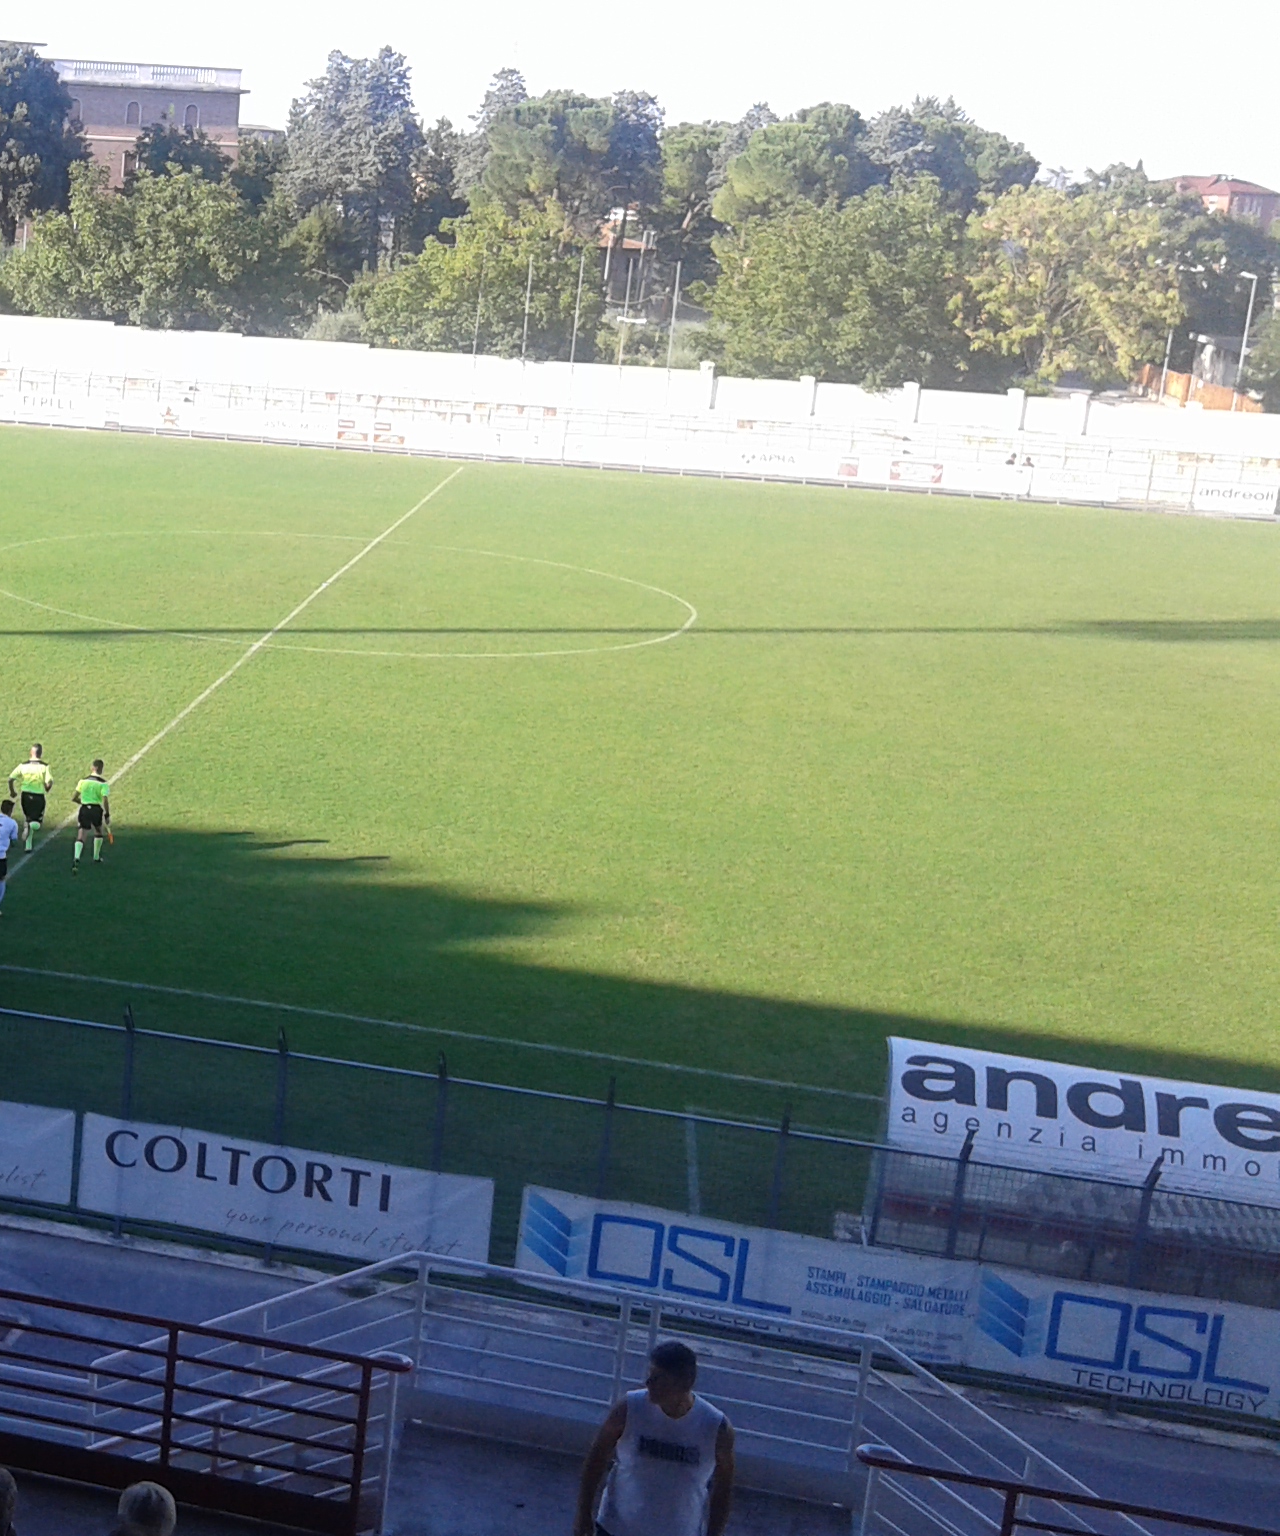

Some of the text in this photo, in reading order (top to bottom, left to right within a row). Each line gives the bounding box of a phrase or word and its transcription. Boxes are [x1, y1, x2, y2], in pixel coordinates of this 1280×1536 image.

[901, 1054, 1280, 1152] andre
[105, 1130, 391, 1213] COLTORTI
[901, 1106, 1280, 1178] agenzia immo
[226, 1208, 272, 1227] your
[277, 1217, 377, 1247] personal
[587, 1213, 792, 1314] OSL
[805, 1280, 891, 1307] ASSEMBLAGGIO
[807, 1266, 847, 1284] STAMPI
[856, 1274, 925, 1298] STAMPAGGIO
[1044, 1290, 1270, 1395] OSL
[1071, 1367, 1266, 1413] TECHNOLOGY
